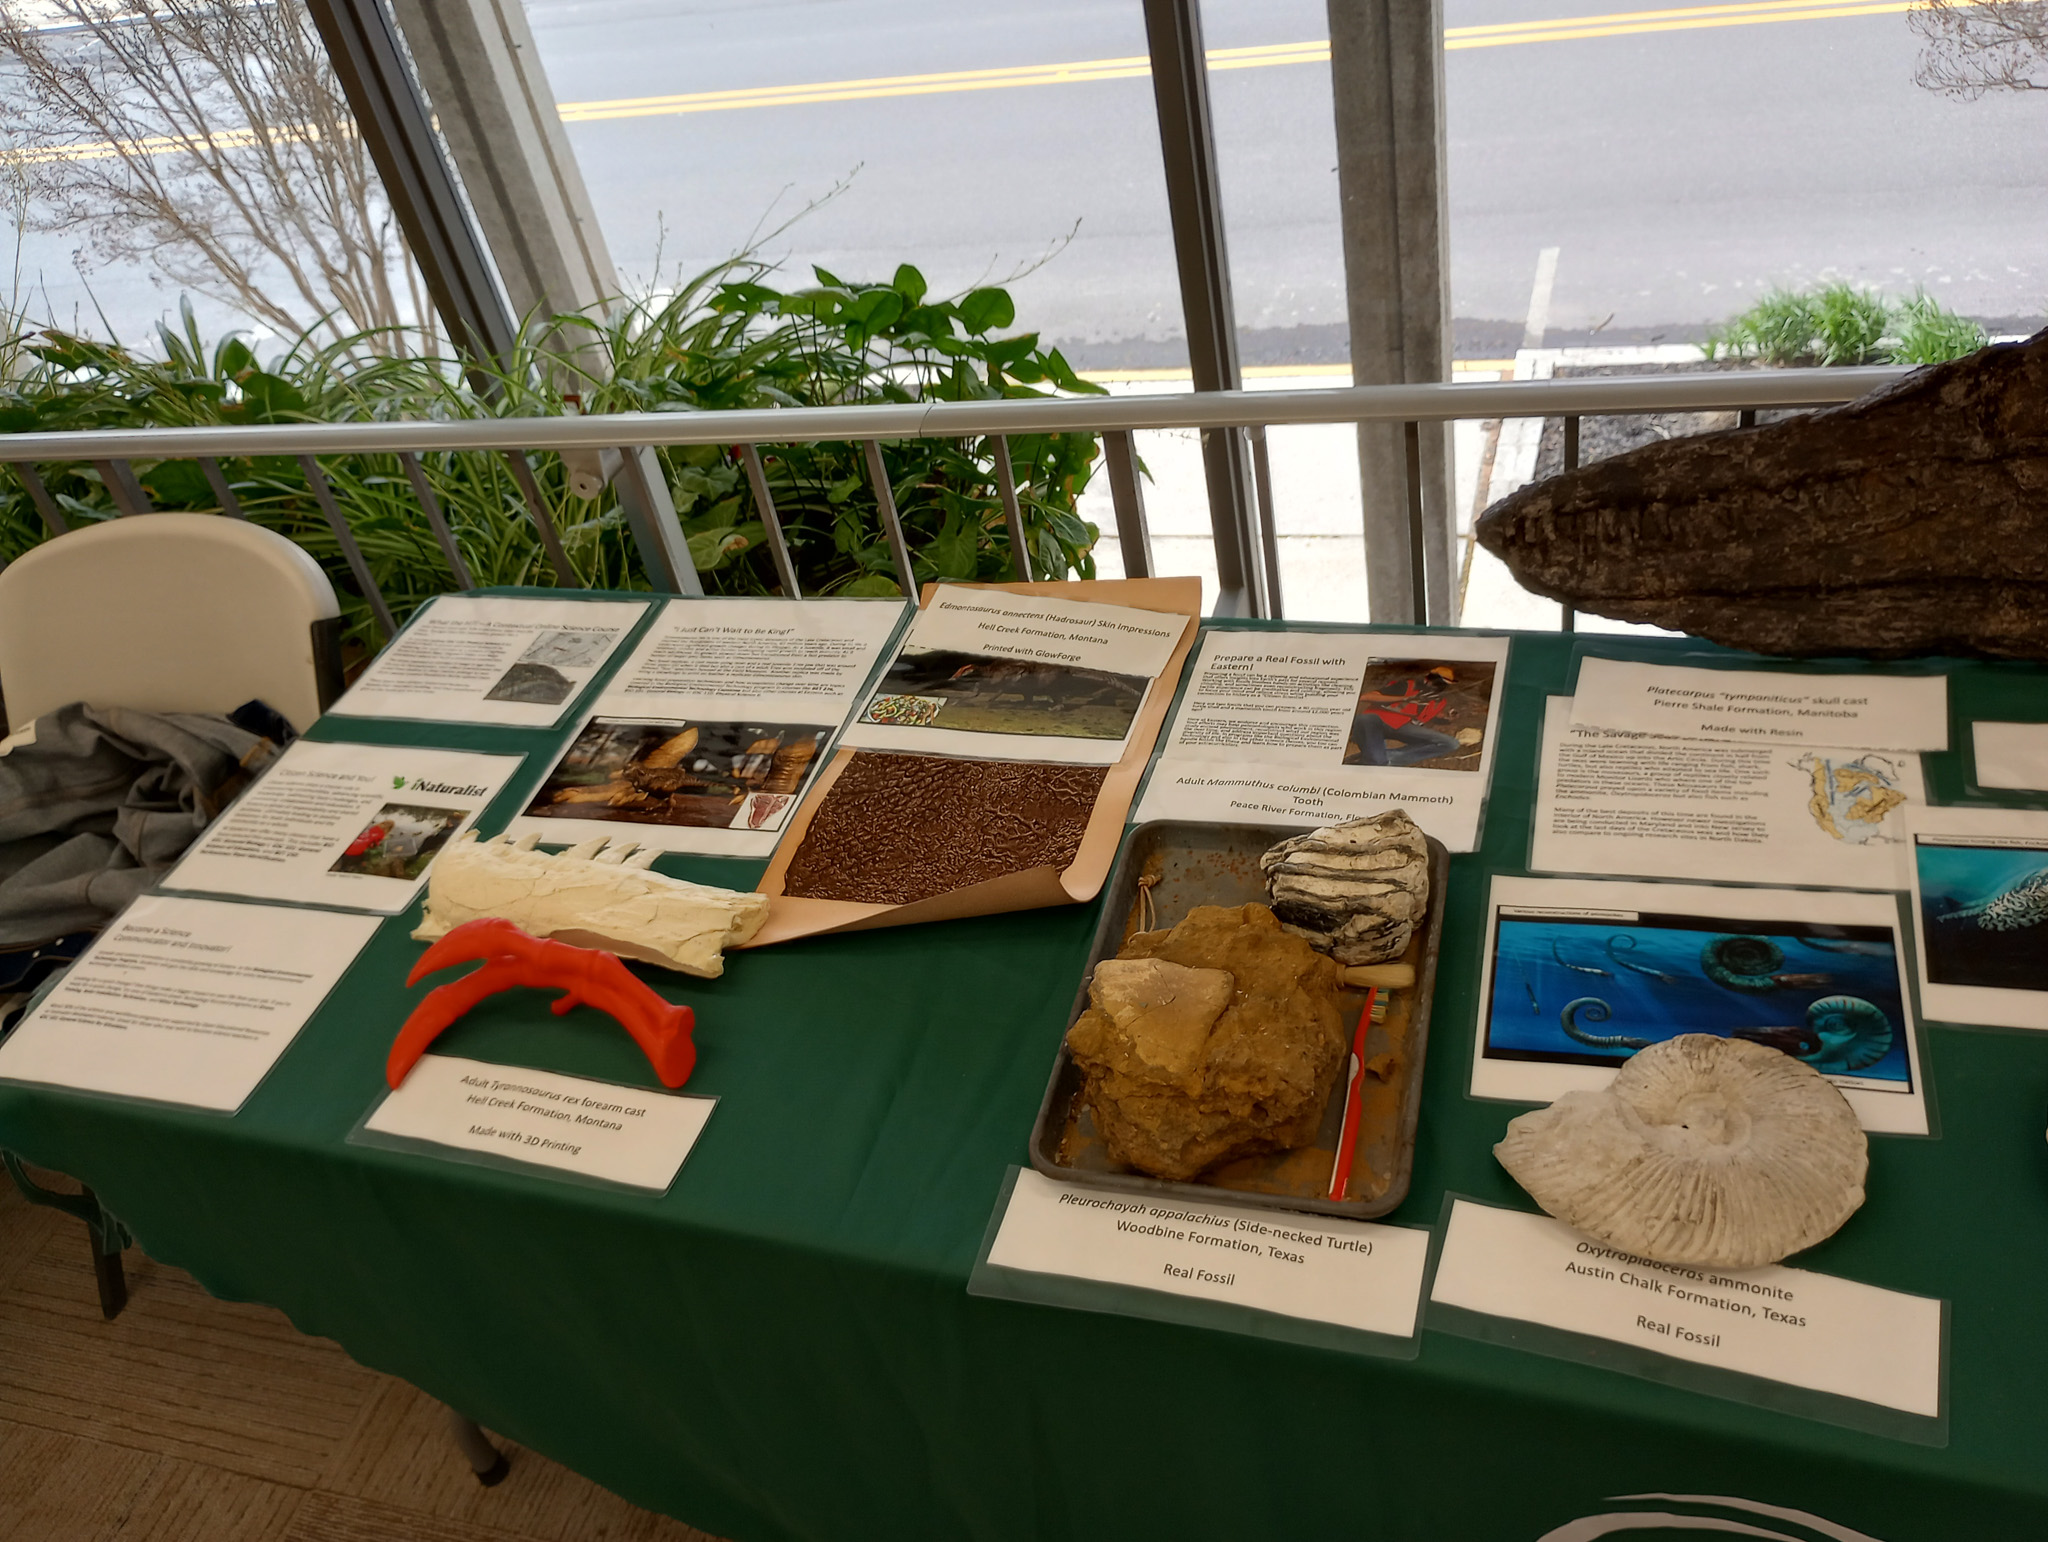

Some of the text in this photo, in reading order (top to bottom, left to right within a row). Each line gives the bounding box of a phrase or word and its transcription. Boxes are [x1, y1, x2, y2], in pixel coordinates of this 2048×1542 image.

[939, 601, 1171, 639] Edmontosaurus annectens (Hadrosaur) Skin Impressions
[978, 622, 1109, 645] Hell Creek Formation, Montana
[982, 643, 1082, 662] Printed with GlowForge
[1214, 655, 1253, 663] Prepare
[1265, 655, 1288, 663] Real
[1290, 656, 1320, 665] Fossil
[1647, 685, 1715, 701] Platecarpus
[1812, 696, 1841, 706] skull
[1842, 697, 1868, 706] cast
[1653, 698, 1859, 719] Pierre Shale Formation, Manitoba
[1700, 723, 1804, 738] Made with Resin
[410, 777, 489, 797] iNaturalist
[1176, 776, 1454, 806] Adult Mammuthus columbi (Colombian Mammoth)
[1230, 800, 1259, 811] Peace
[1261, 803, 1288, 814] River
[1289, 807, 1343, 822] Formation,
[1293, 796, 1324, 807] Tooth
[459, 1075, 646, 1117] Adult Tyrannosaurus rex forearm cast
[466, 1094, 623, 1131] Hell Creek Formation, Montana
[468, 1125, 582, 1155] Made with 3D Printing
[1058, 1193, 1373, 1256] Pleurochayah appalachius (Side-necked Turtle)
[1116, 1219, 1305, 1264] Woodbine Formation, Texas
[1163, 1263, 1235, 1286] Real Fossil
[1709, 1272, 1794, 1302] ammonite
[1564, 1261, 1807, 1328] Austin Chalk Formation, Texas
[1636, 1314, 1721, 1348] Real Fossil
